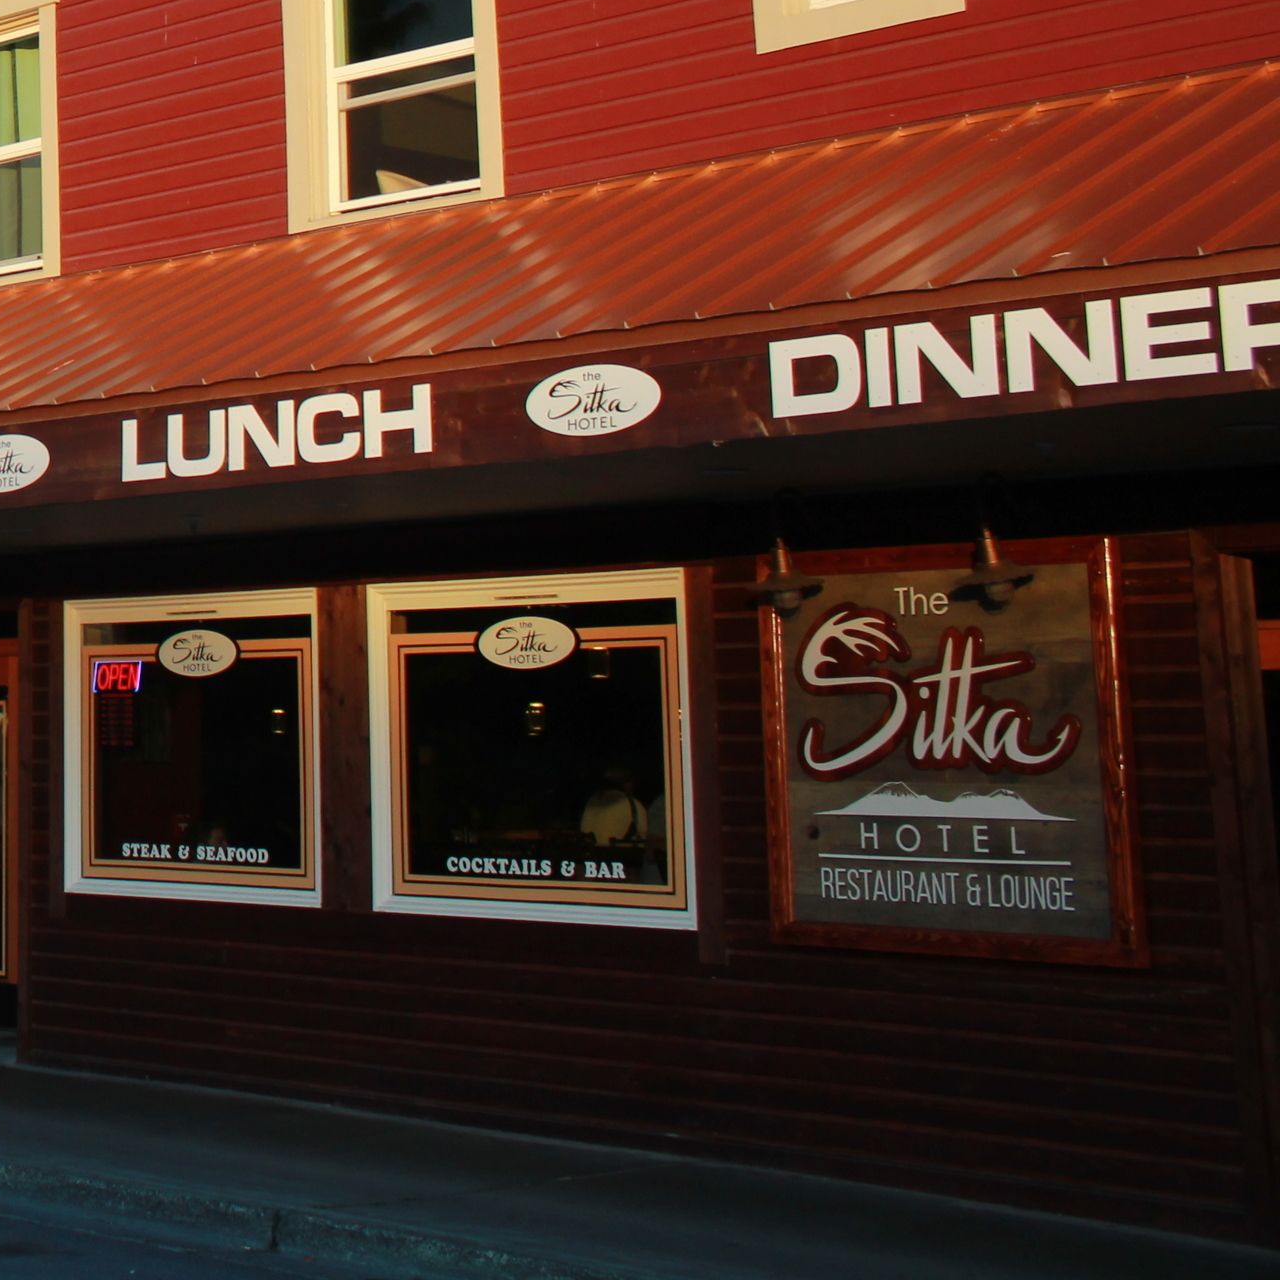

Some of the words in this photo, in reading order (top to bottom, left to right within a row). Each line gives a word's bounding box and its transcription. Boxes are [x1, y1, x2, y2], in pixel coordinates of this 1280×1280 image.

[582, 371, 601, 381] the
[547, 379, 637, 420] Sitka
[121, 383, 433, 483] LUNCH
[567, 416, 617, 431] HOTEL
[894, 587, 949, 616] The
[172, 638, 223, 664] Sitka
[495, 626, 558, 655] Sitka
[183, 663, 211, 672] HOTEL
[509, 655, 544, 664] HOTEL
[97, 664, 138, 690] OPEN
[801, 610, 1072, 771] Sitka
[860, 822, 1025, 855] HOTEL
[122, 843, 172, 858] STEAK
[178, 845, 189, 859] &
[196, 846, 269, 863] SEAFOOD
[446, 856, 552, 876] COCKTAILS
[561, 860, 575, 877] &
[584, 861, 626, 879] BAR
[820, 867, 959, 904] RESTAURANT
[966, 874, 982, 907] &
[987, 874, 1076, 912] LOUNGE
